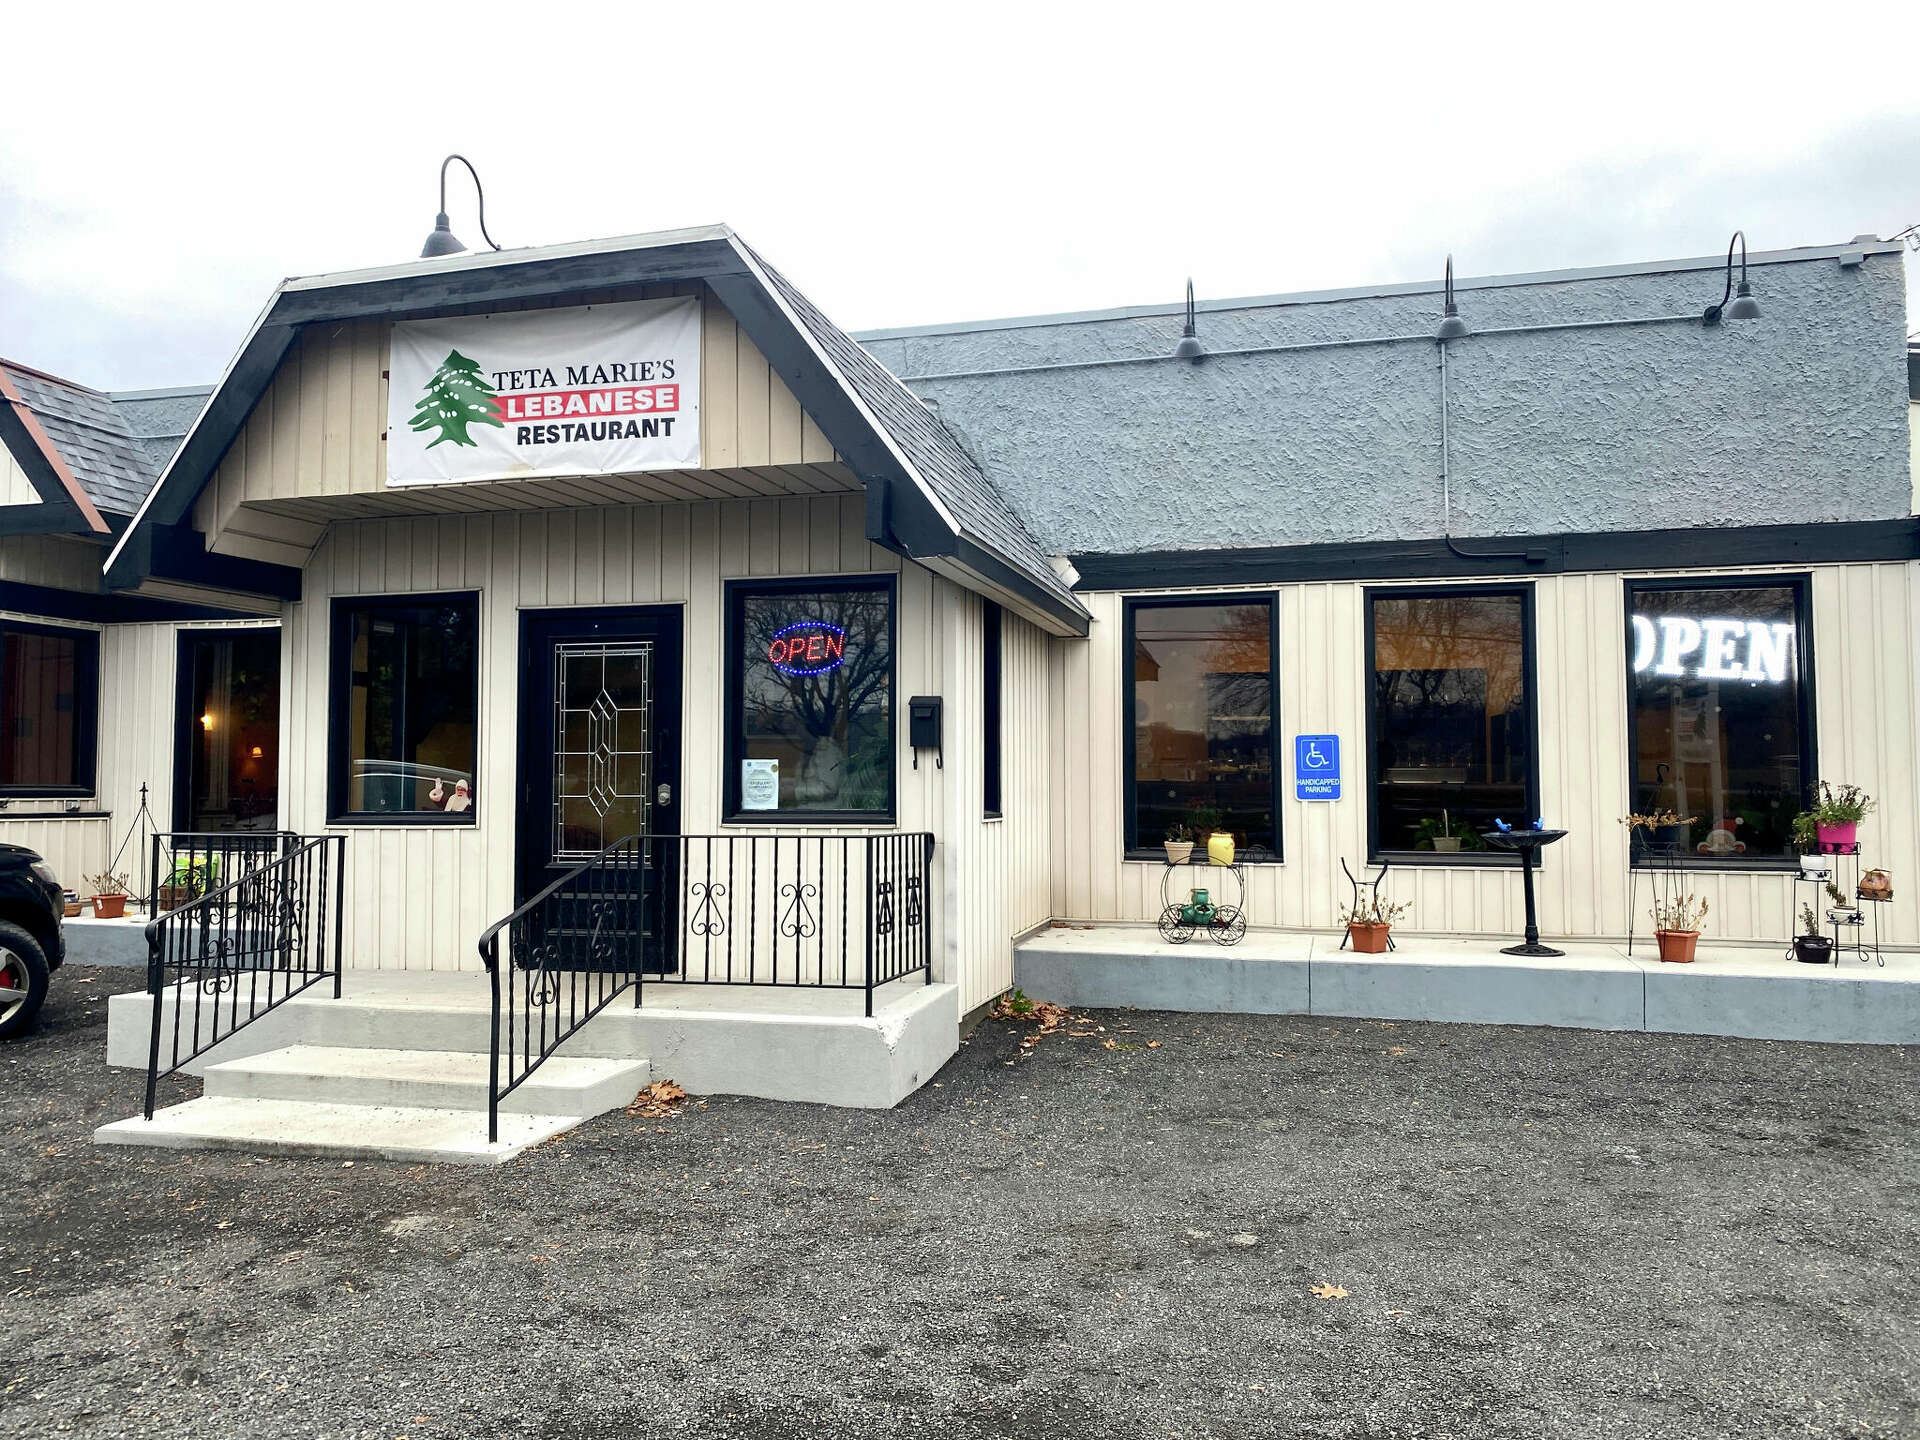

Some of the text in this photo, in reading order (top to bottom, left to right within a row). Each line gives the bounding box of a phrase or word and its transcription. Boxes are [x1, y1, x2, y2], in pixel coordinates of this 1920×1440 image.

[492, 359, 675, 391] TETA MARIE'S
[507, 387, 675, 418] LEBANESE
[517, 417, 675, 445] RESTAURANT
[769, 634, 845, 663] OPEN
[1297, 778, 1340, 786] HANDICAPPED
